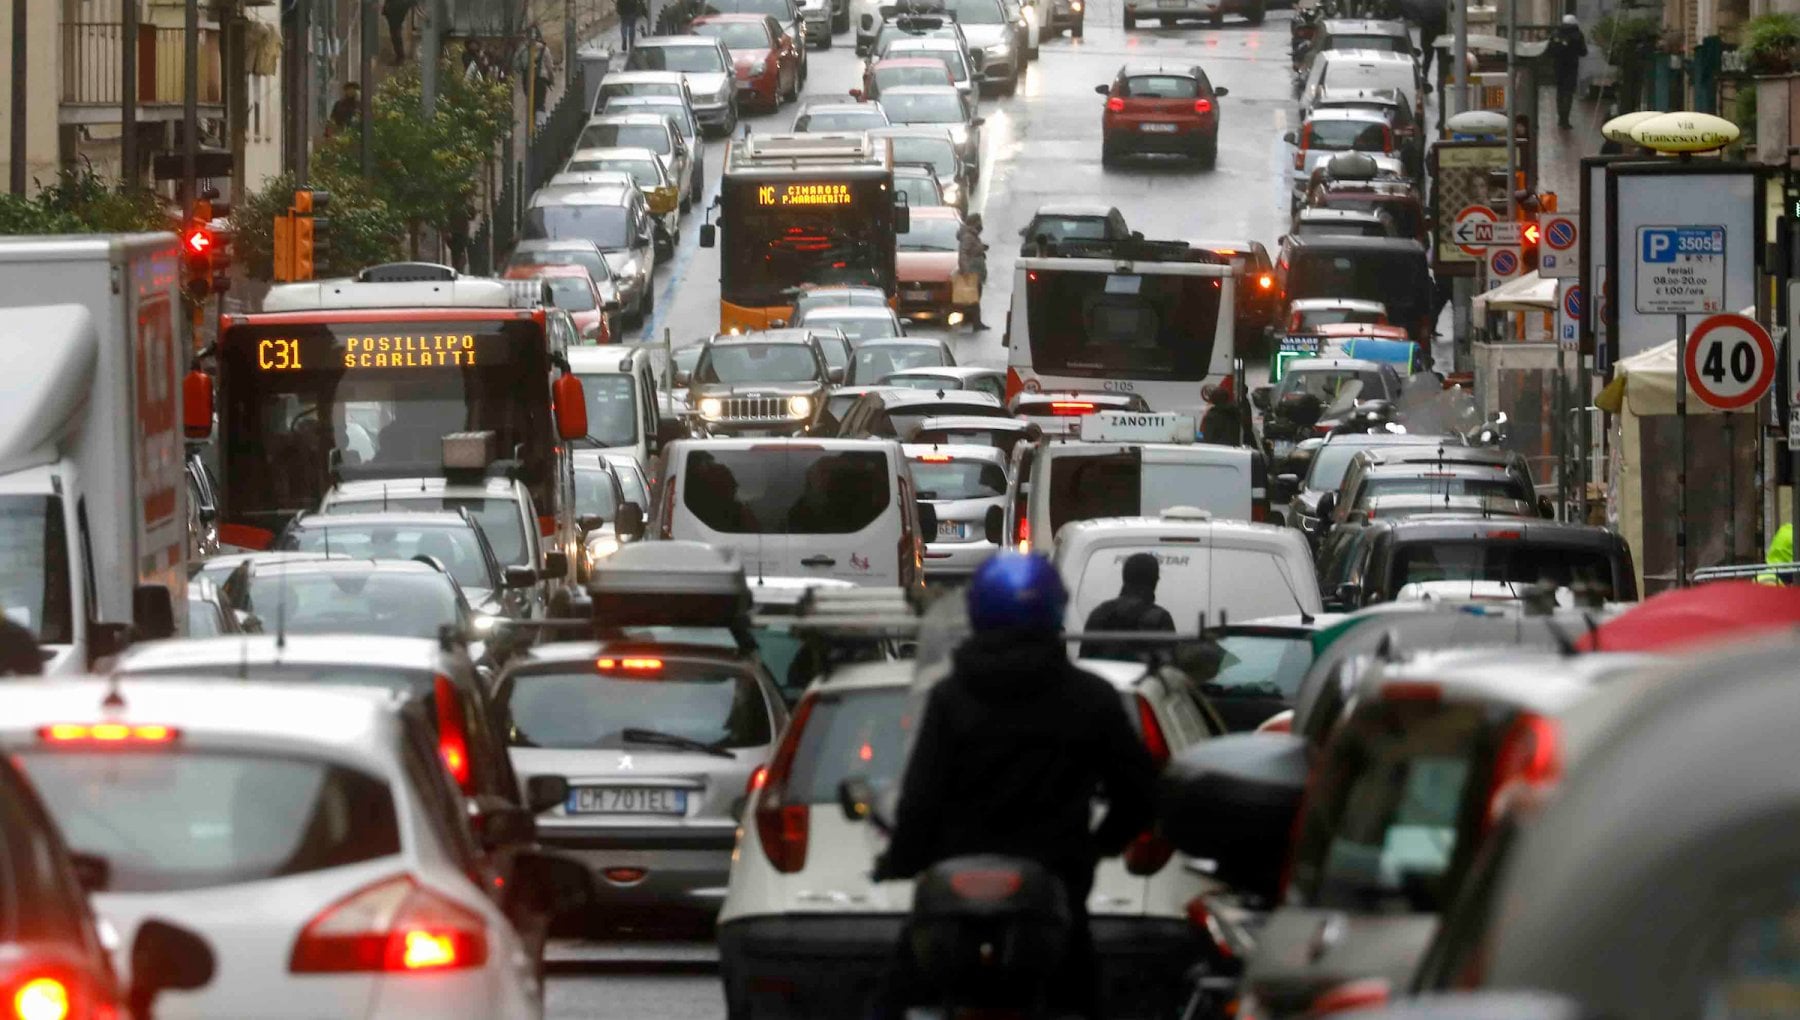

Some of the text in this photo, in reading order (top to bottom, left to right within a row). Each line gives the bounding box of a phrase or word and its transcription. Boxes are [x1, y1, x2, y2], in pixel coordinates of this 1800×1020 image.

[1677, 121, 1694, 130] via
[1641, 132, 1698, 143] Francesco
[788, 185, 847, 195] CIMAROSA
[1678, 236, 1711, 251] 3505
[259, 335, 474, 369] C31 POSILLIPO
[344, 350, 476, 367] SCARLATTI
[1702, 341, 1756, 383] 40
[1111, 416, 1165, 427] ZANOTTI
